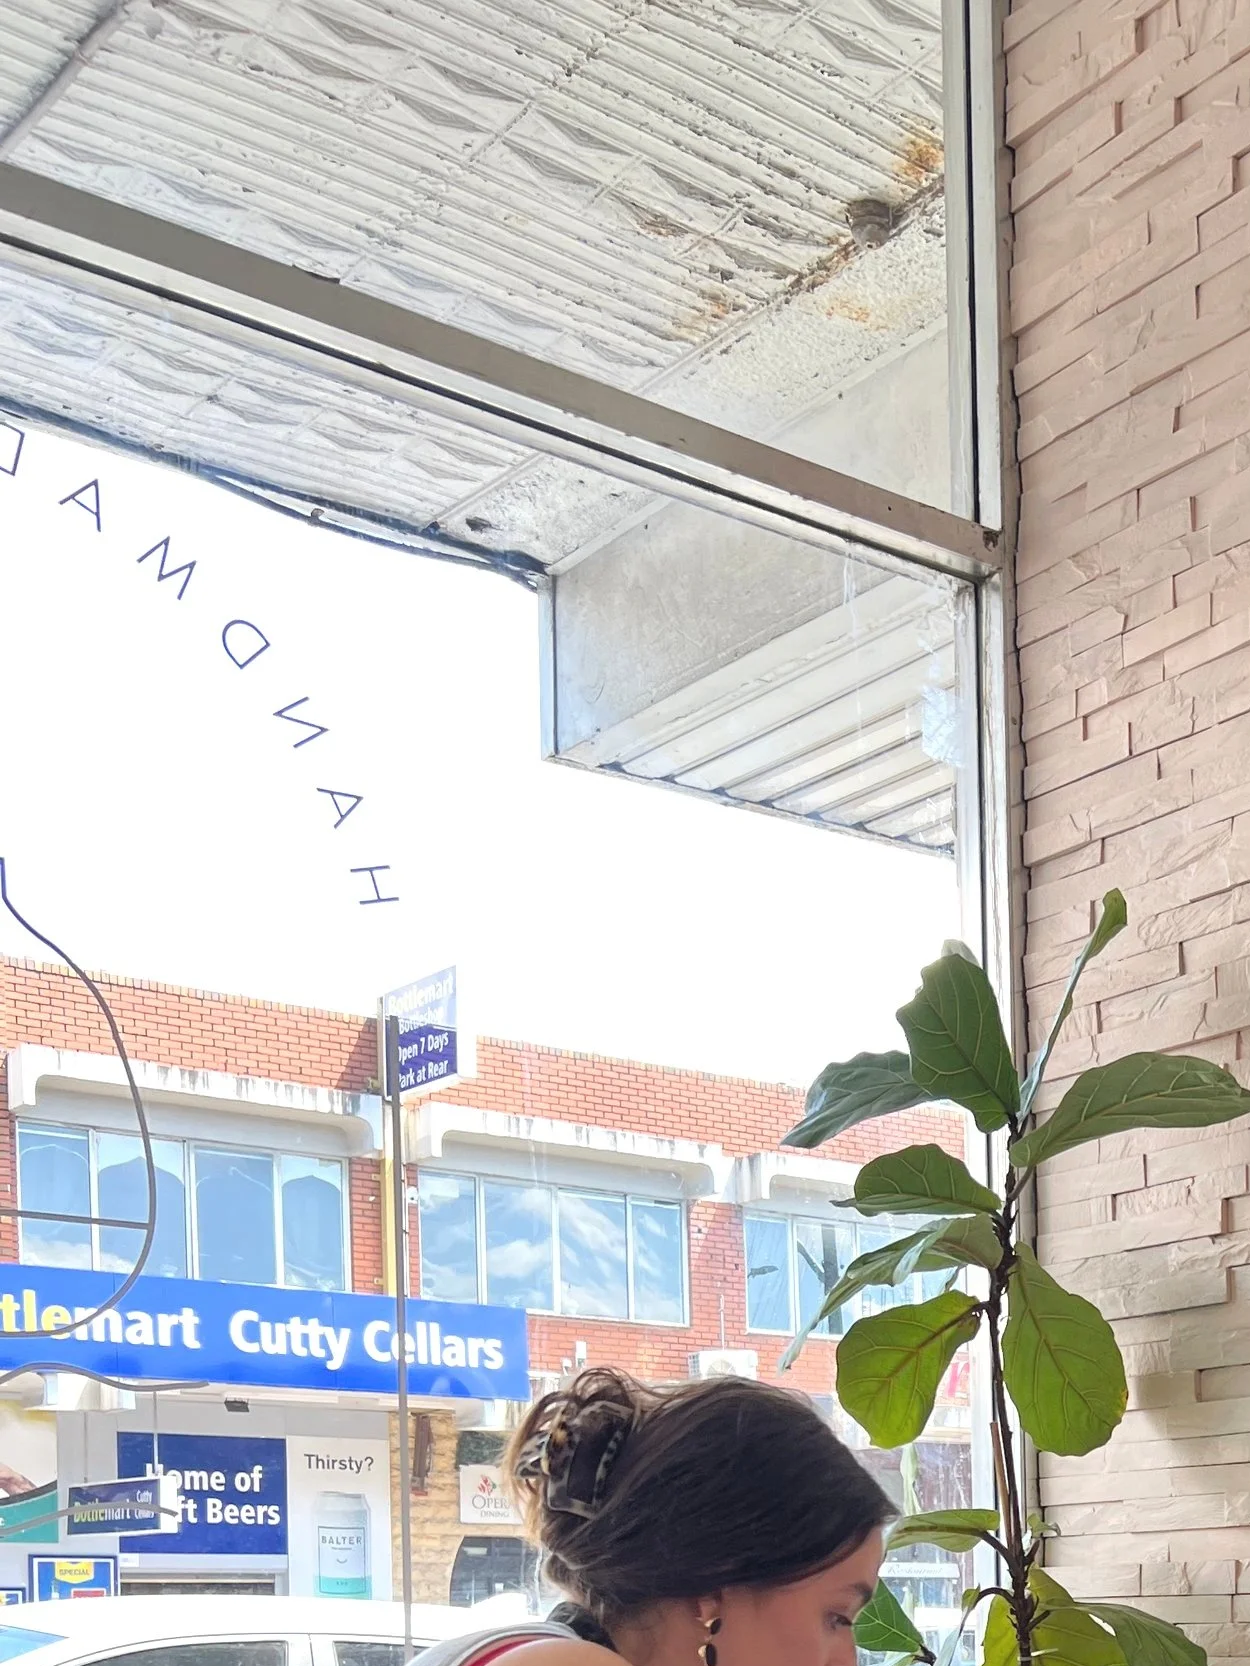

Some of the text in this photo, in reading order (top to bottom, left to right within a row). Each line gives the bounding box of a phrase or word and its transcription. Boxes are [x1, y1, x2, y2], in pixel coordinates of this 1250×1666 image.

[420, 1036, 426, 1054] 7
[427, 1032, 449, 1052] Days
[398, 1060, 448, 1088] ark at Rear
[228, 1309, 350, 1371] Cutty
[362, 1319, 504, 1370] Cellars
[303, 1453, 374, 1474] Thirsty?
[234, 1465, 263, 1492] of
[206, 1498, 280, 1525] Beers
[471, 1495, 513, 1510] OPER
[321, 1535, 363, 1545] BALTER
